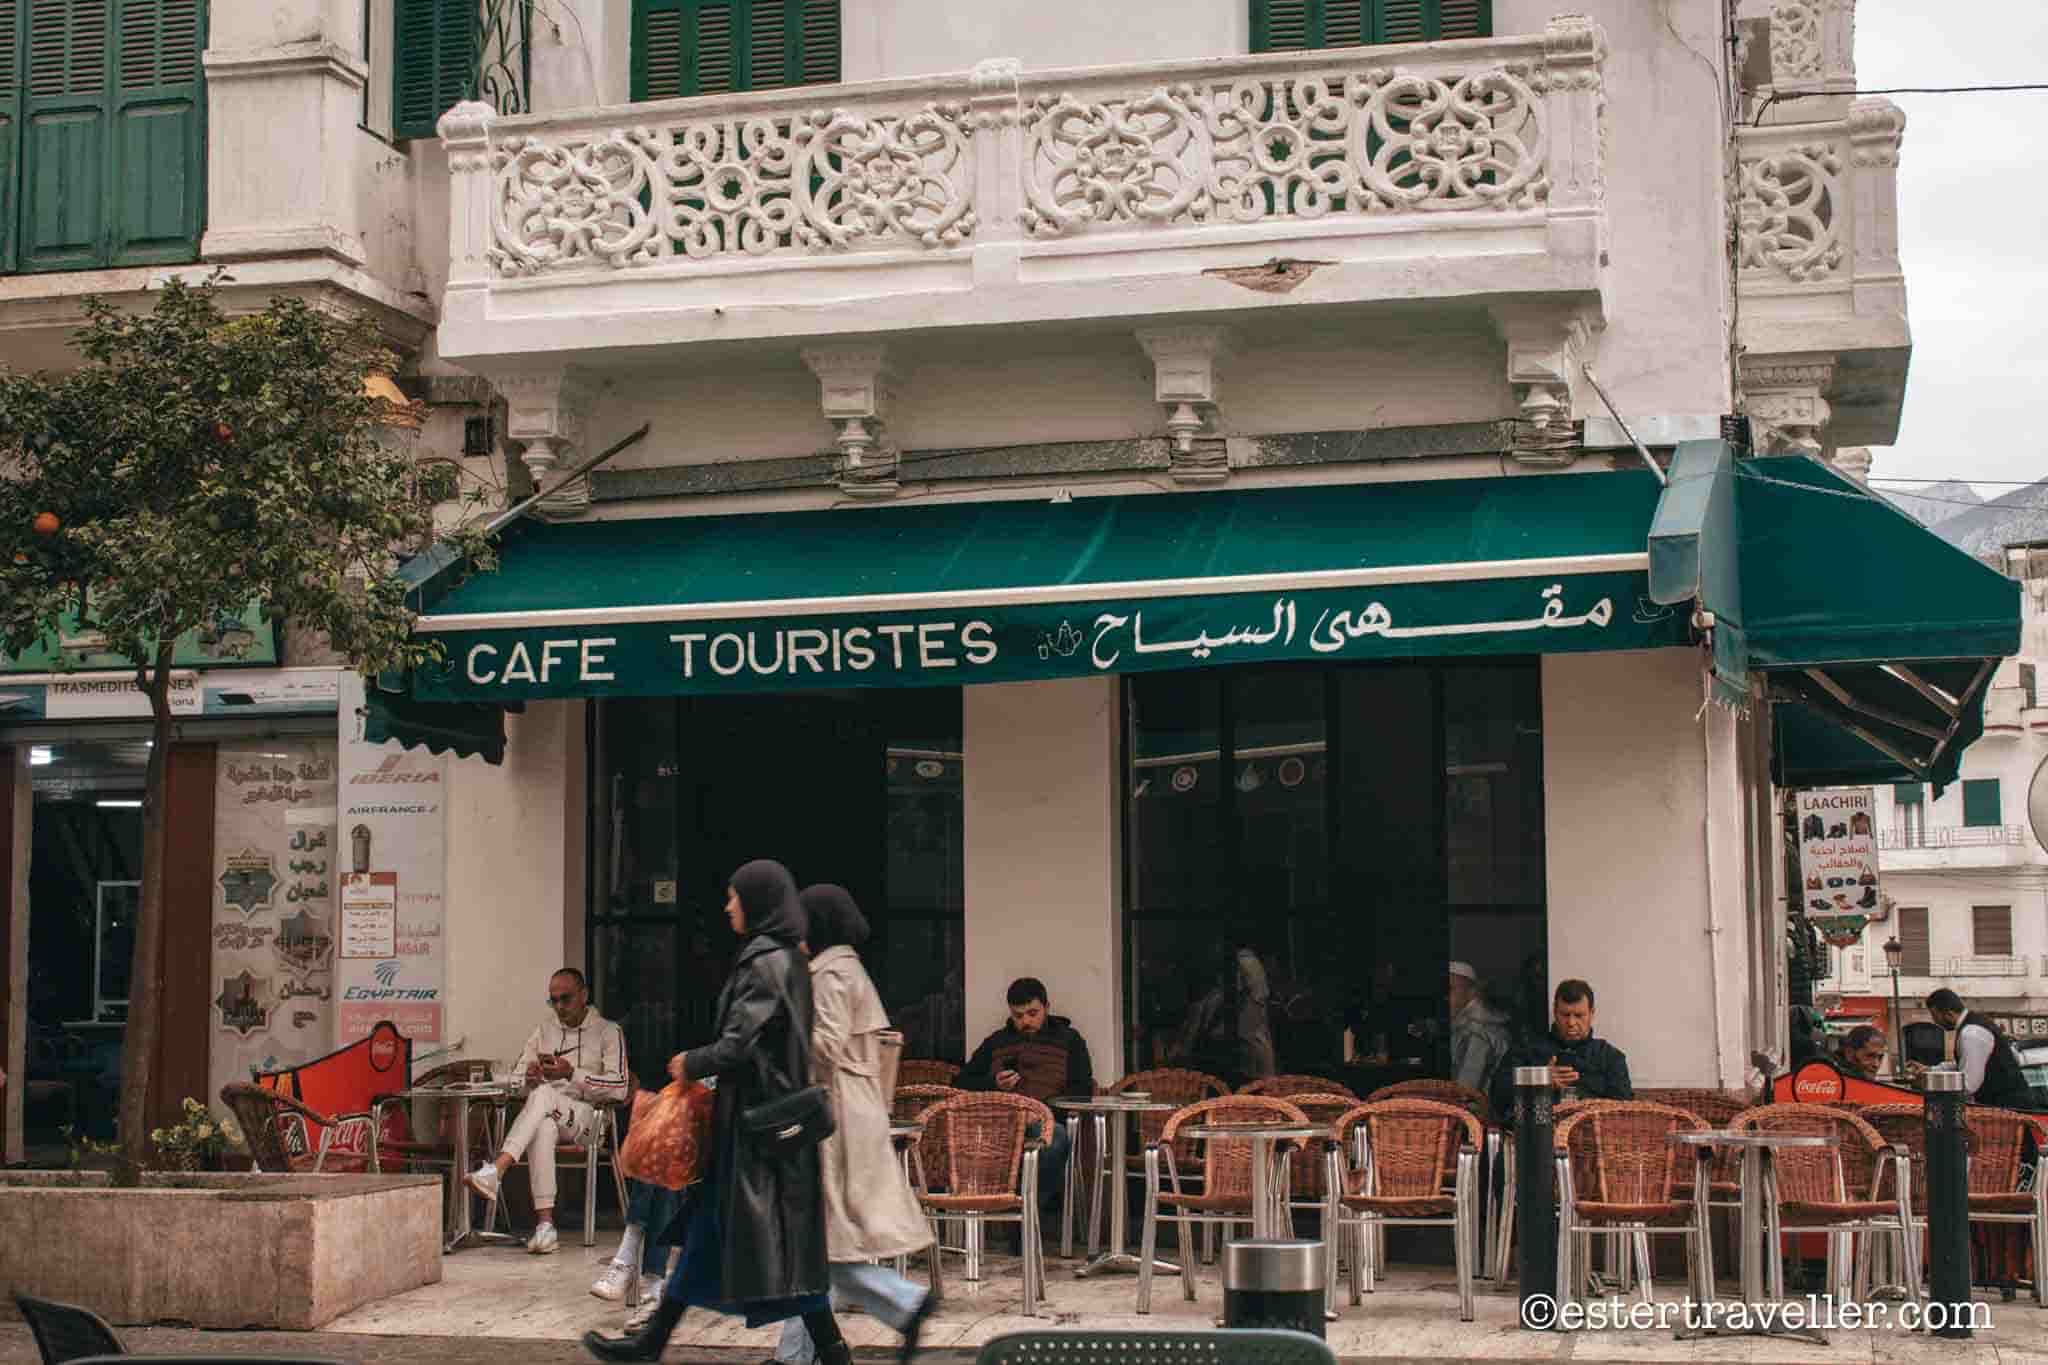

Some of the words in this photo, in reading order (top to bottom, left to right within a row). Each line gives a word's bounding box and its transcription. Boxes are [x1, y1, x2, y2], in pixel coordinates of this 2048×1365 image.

[1090, 597, 1296, 669] السياح
[466, 636, 617, 685] CAFE
[669, 621, 999, 678] TOURISTES
[53, 679, 195, 694] TRASMEDITENEA
[1804, 795, 1868, 810] LAACHIRI
